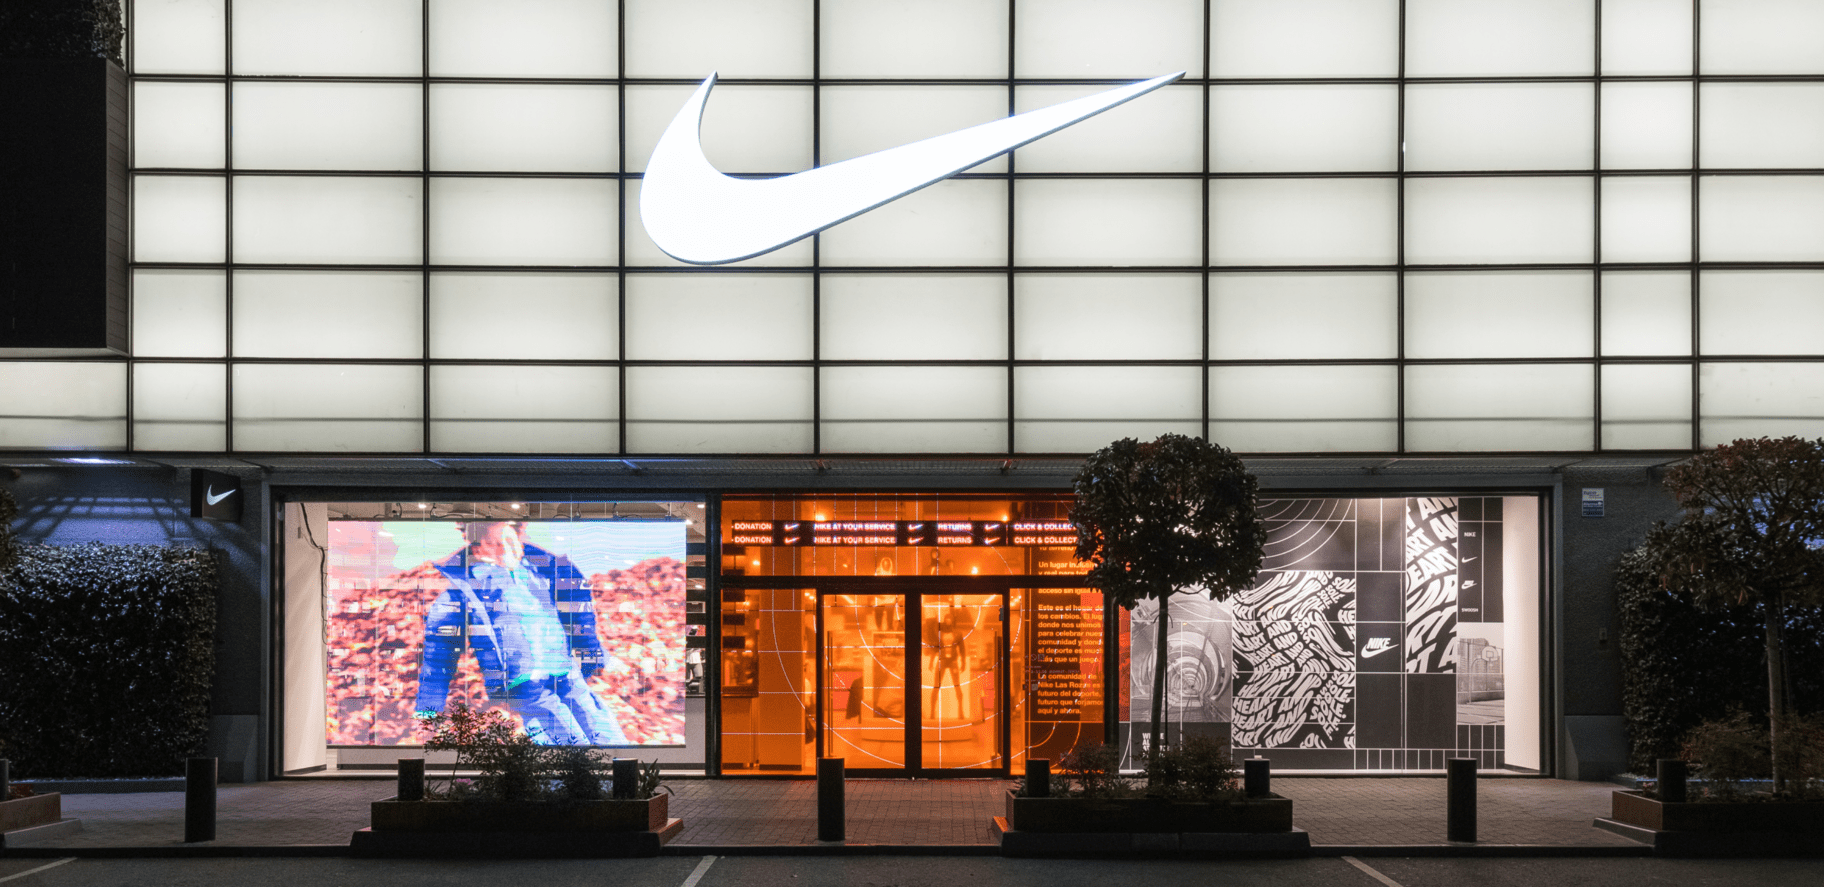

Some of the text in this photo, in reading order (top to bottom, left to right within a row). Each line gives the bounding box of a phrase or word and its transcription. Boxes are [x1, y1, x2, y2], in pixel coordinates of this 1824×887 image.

[937, 536, 972, 544] RETURNS
[1014, 536, 1036, 544] CLICK
[1037, 536, 1043, 544] &
[1044, 536, 1077, 544] COLLECT
[1049, 561, 1068, 569] lugar
[1273, 631, 1298, 651] AND
[1367, 637, 1392, 649] NIKE
[1284, 641, 1304, 661] AND
